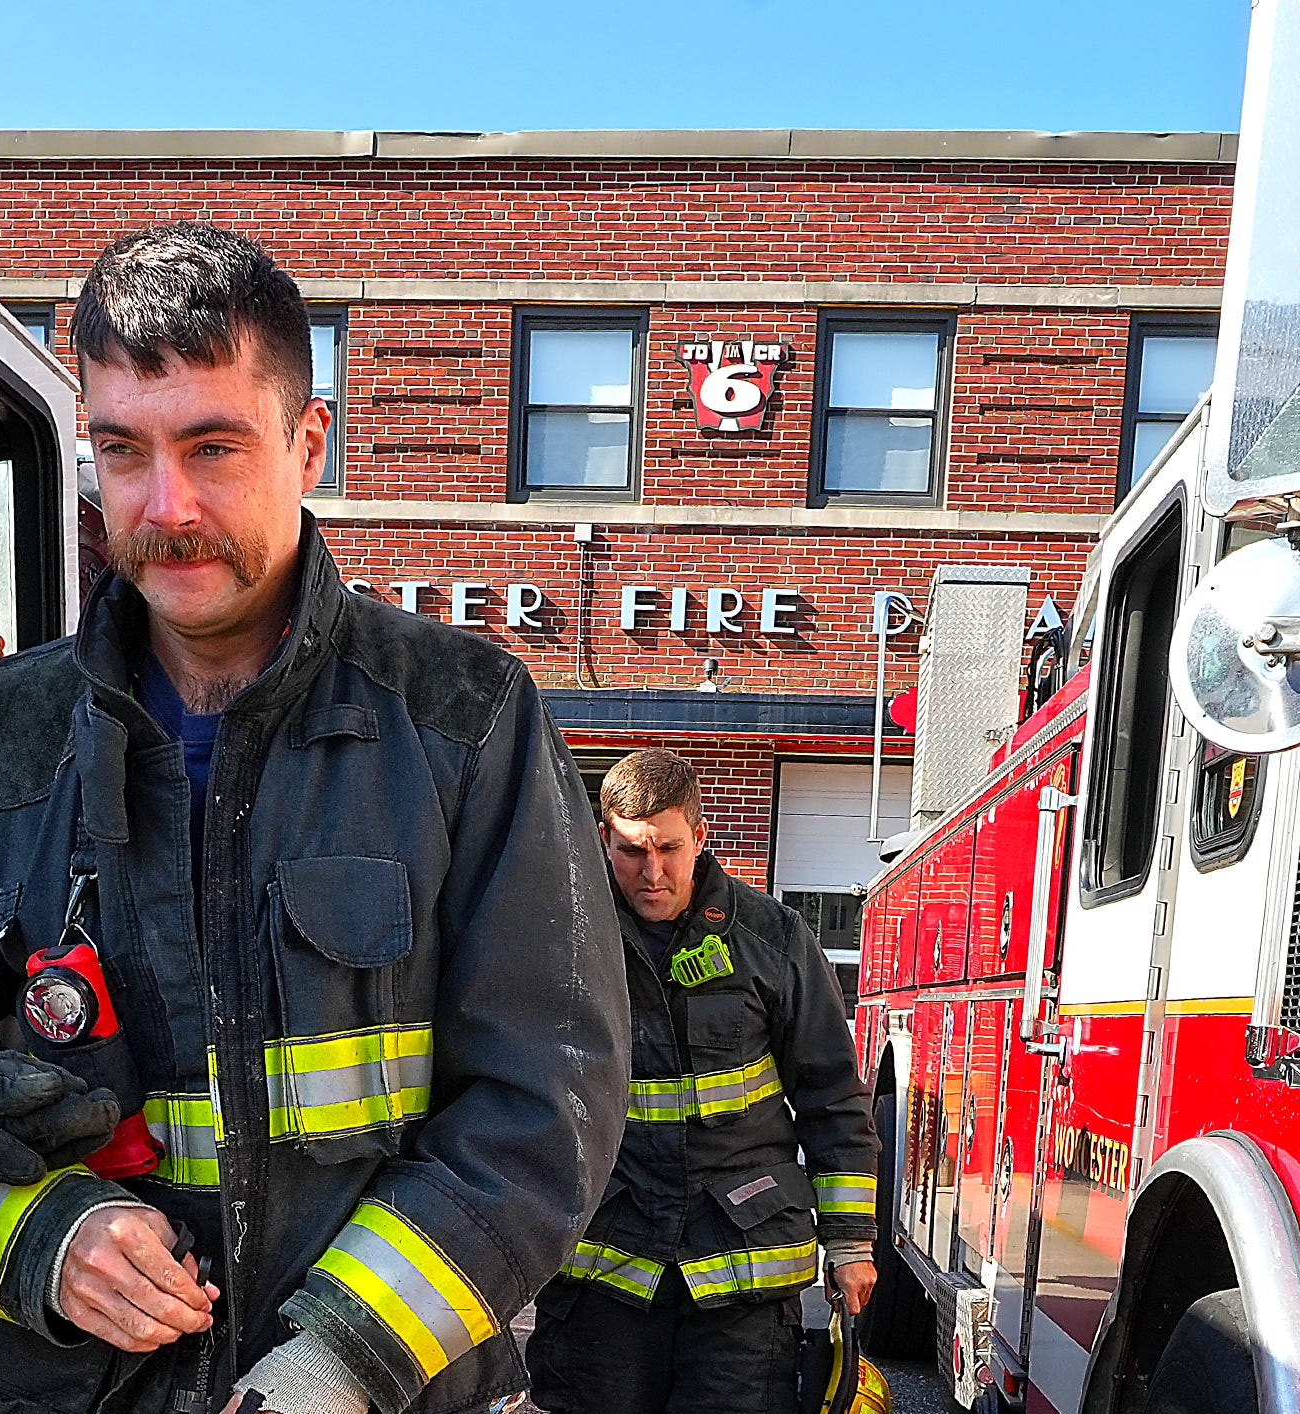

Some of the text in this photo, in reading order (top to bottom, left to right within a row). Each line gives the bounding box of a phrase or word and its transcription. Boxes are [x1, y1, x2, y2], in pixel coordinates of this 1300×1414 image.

[754, 345, 781, 360] CR
[700, 363, 759, 413] 6
[621, 585, 798, 634] FIRE
[1054, 1119, 1129, 1193] WORCESTER
